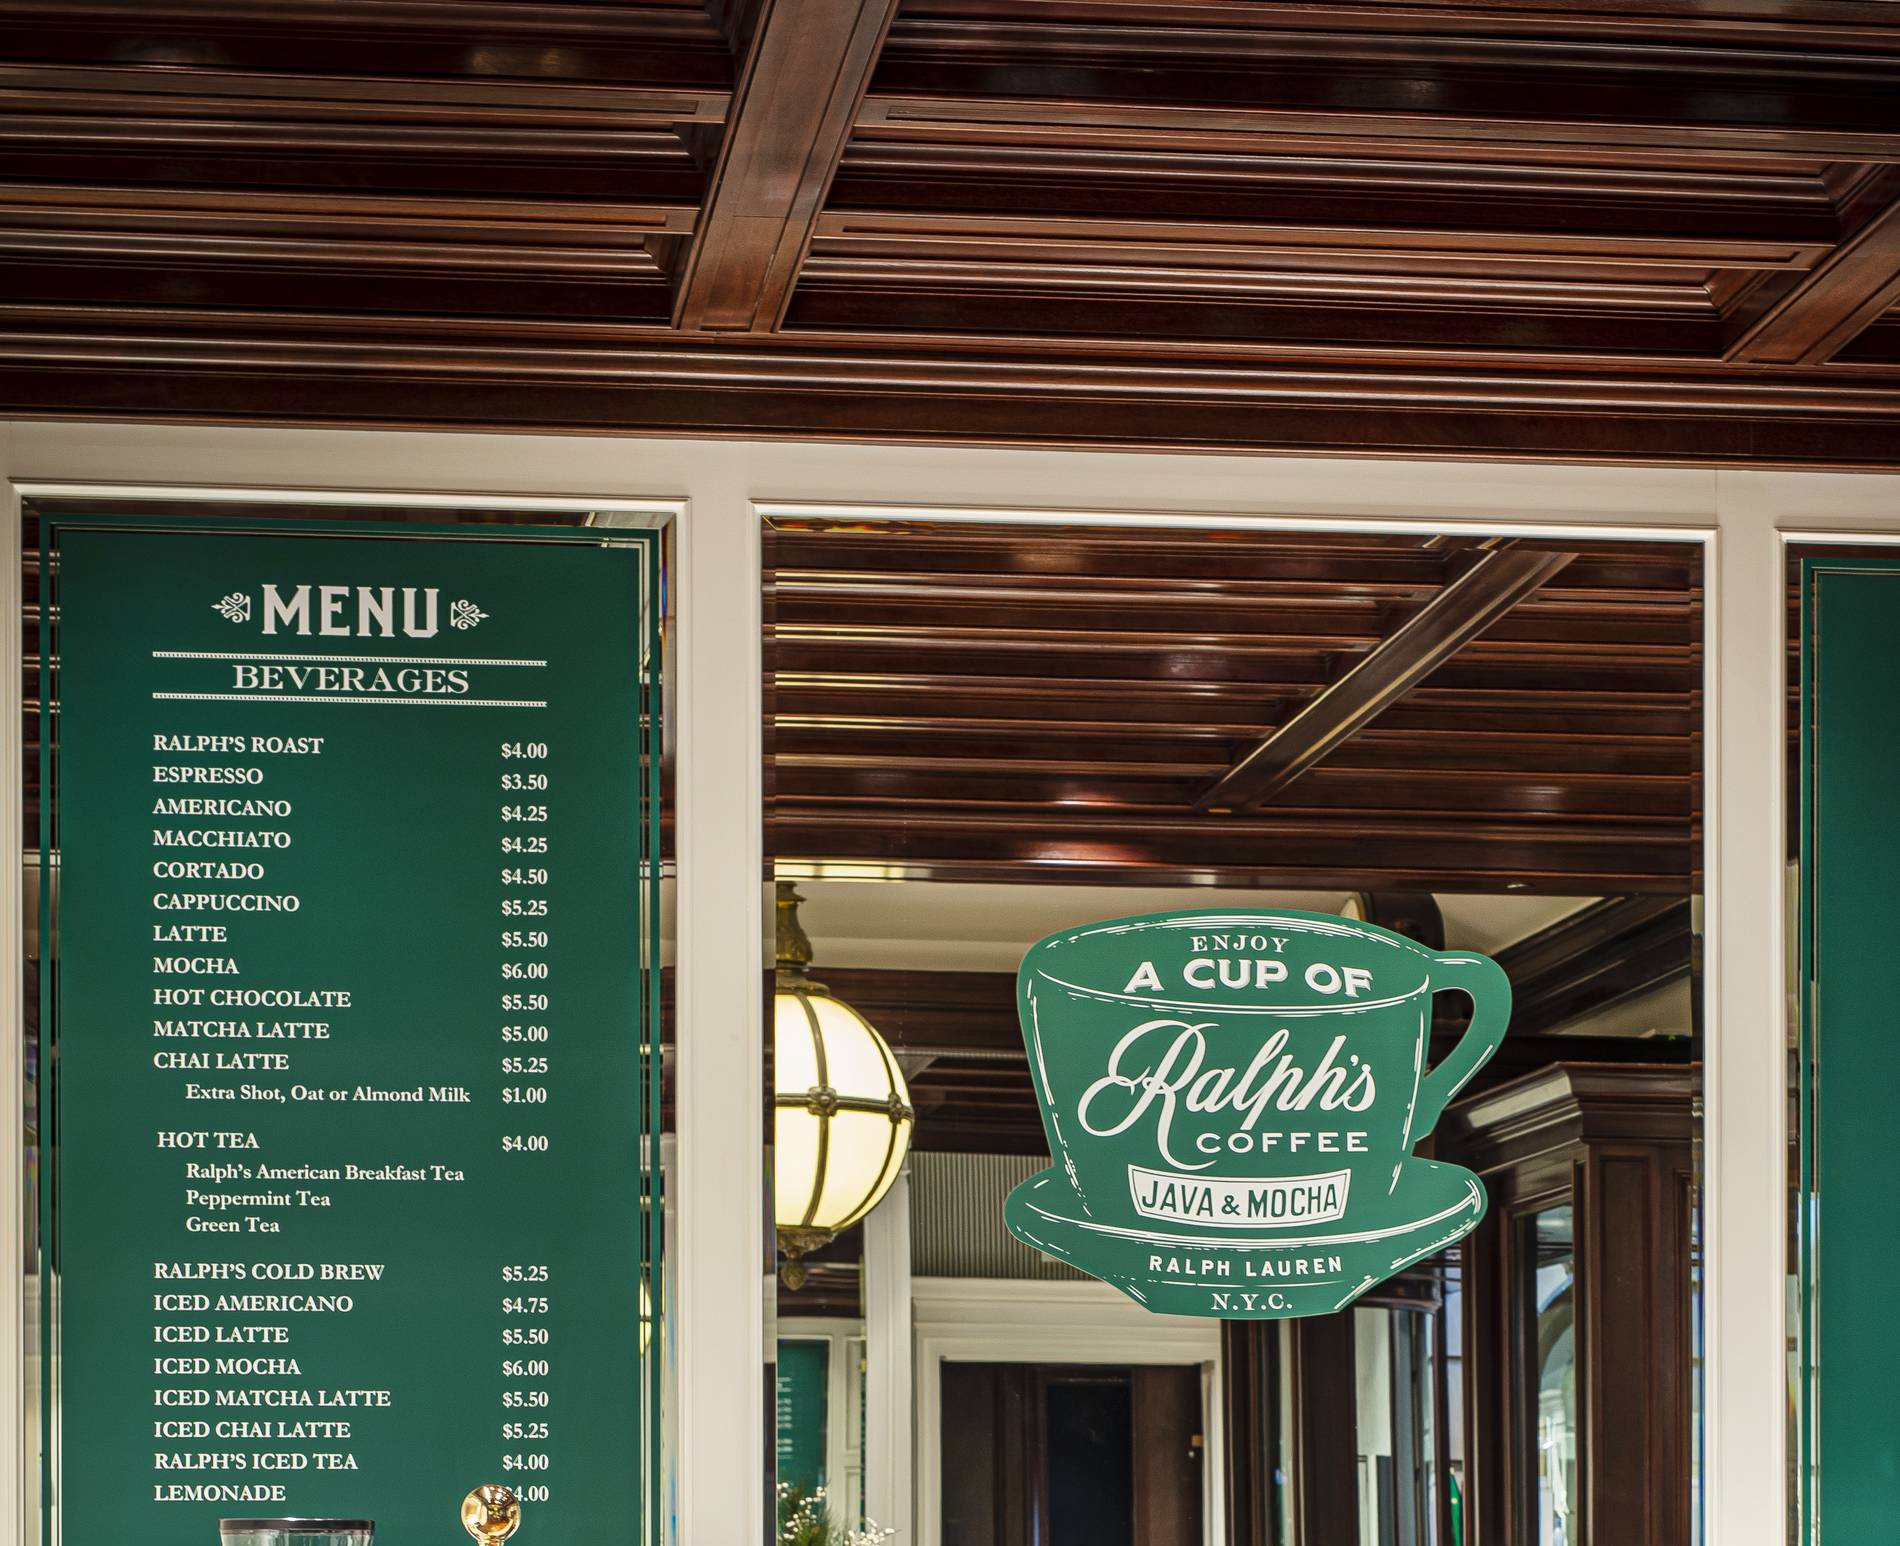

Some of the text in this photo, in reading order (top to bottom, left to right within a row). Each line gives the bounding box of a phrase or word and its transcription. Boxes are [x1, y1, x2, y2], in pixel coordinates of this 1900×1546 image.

[261, 583, 440, 639] MENU
[232, 664, 469, 694] BEVERAGES
[153, 734, 548, 760] RALPH'S ROAST $4.00
[152, 766, 548, 791] ESPRESSO $3.50
[151, 798, 548, 823] AMERICANO $4.25
[152, 829, 548, 854] MACCHIATO $4.25
[153, 861, 548, 886] CORTADO $4.50
[153, 892, 548, 917] CAPPUCCINO $5.25
[152, 925, 549, 949] LATTE $5.50
[1191, 935, 1289, 953] ENJOY
[152, 956, 549, 980] MOCHA $6.00
[1123, 959, 1373, 998] A CUP OF
[153, 988, 549, 1012] HOT CHOCOLATE $5.50
[153, 1020, 549, 1043] MATCHA LATTE $5.00
[153, 1051, 549, 1074] CHAI LATTE $5.25
[185, 1083, 547, 1105] Extra Shot, Oat or Almond Milk $1.00
[1078, 1019, 1377, 1171] Ralph's
[157, 1131, 549, 1153] HOT TEA $4.00
[1196, 1131, 1368, 1153] COFFEE
[185, 1162, 465, 1184] Ralph's American Breakfast Tea
[185, 1189, 331, 1211] Peppermint Tea
[1142, 1180, 1338, 1217] JAVA & MOCHA
[185, 1216, 281, 1233] Green Tea
[154, 1262, 549, 1283] RALPH'S COLD BREW $5.25
[1148, 1255, 1342, 1278] RALPH LAUREN
[153, 1294, 549, 1315] ICED AMERICANO $4.75
[1211, 1292, 1294, 1311] N.Y.C.
[153, 1325, 549, 1346] ICED LATTE $5.50
[153, 1357, 549, 1377] ICED MOCHA $6.00
[154, 1389, 549, 1409] ICED MATCHA LATTE $5.50
[153, 1421, 549, 1440] ICED CHAI LATTE $5.25
[154, 1452, 550, 1472] RALPH'S ICED TEA $4.00
[153, 1484, 550, 1503] LEMONADE 4.00
